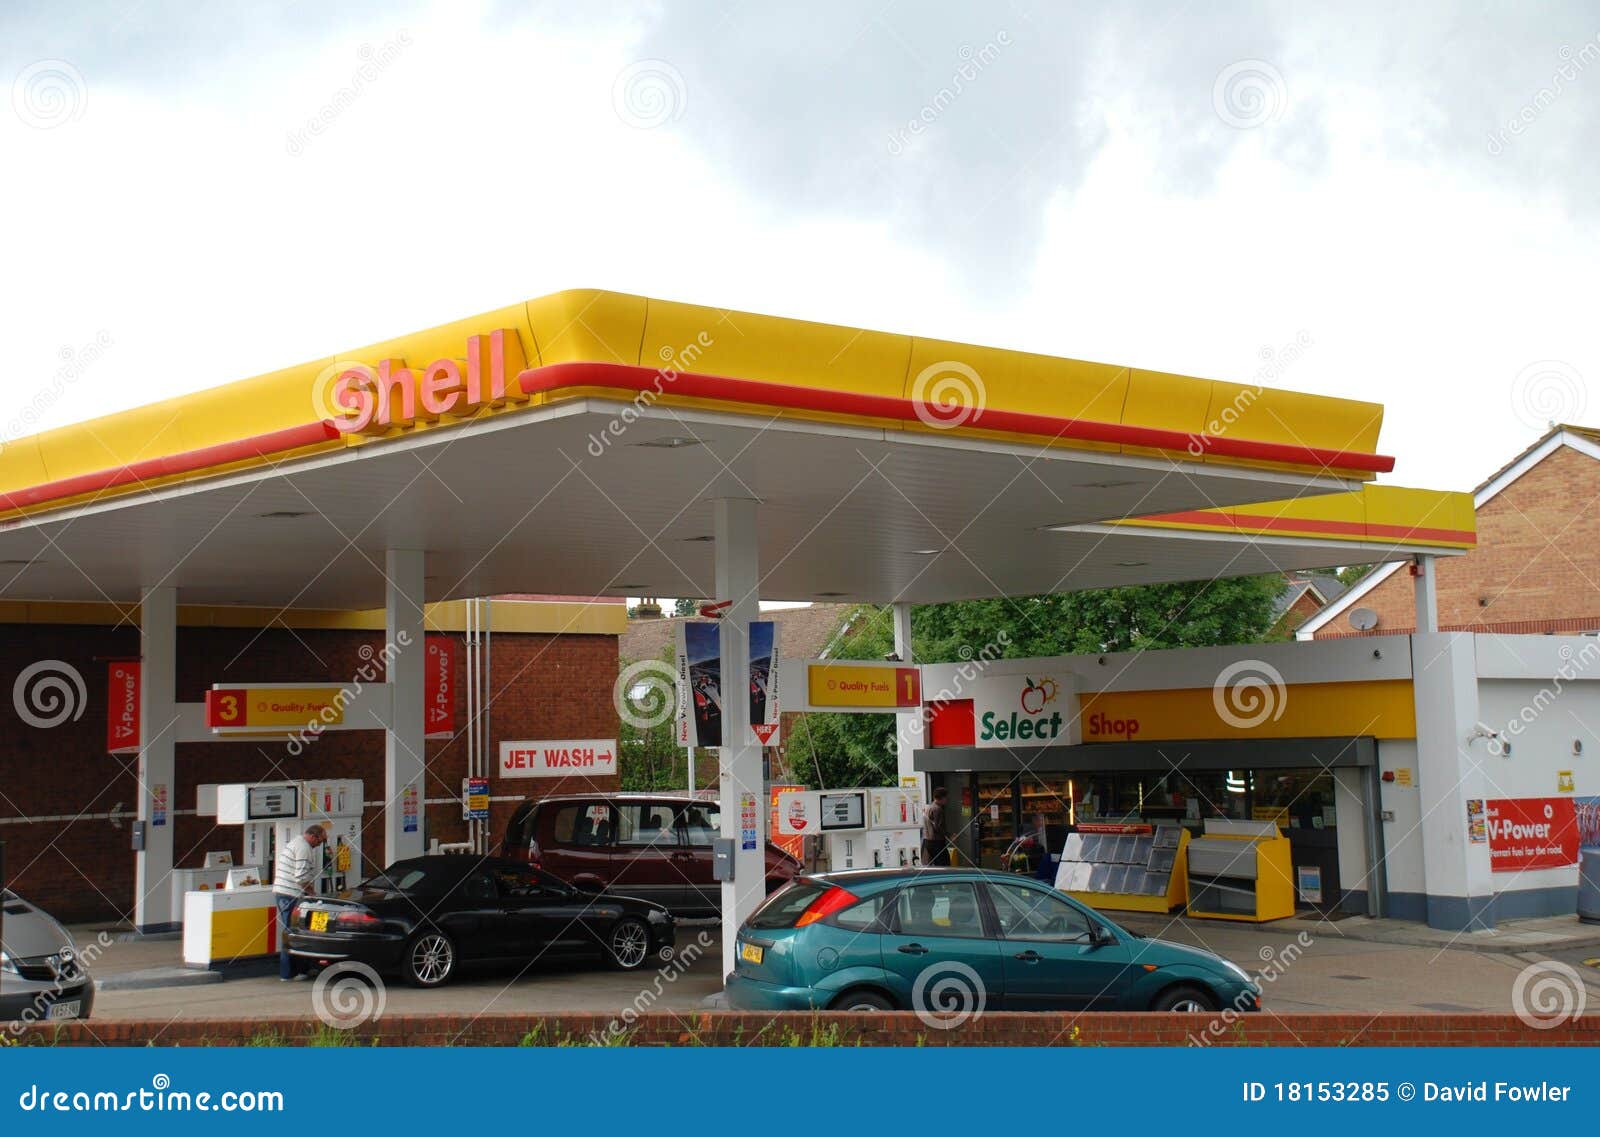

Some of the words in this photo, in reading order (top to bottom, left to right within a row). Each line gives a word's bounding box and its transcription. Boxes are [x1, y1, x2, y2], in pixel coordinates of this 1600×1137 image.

[335, 328, 506, 433] Shell
[437, 649, 449, 722] V-Power
[840, 681, 868, 693] Quality
[871, 681, 889, 692] Fuels
[904, 674, 913, 700] 1
[122, 673, 135, 738] V-Power
[220, 695, 238, 721] 3
[271, 703, 304, 715] Quality
[980, 711, 1063, 741] Select
[1089, 713, 1140, 740] Shop
[504, 750, 537, 769] JET
[544, 748, 594, 768] WASH
[1487, 819, 1551, 841] V-Power
